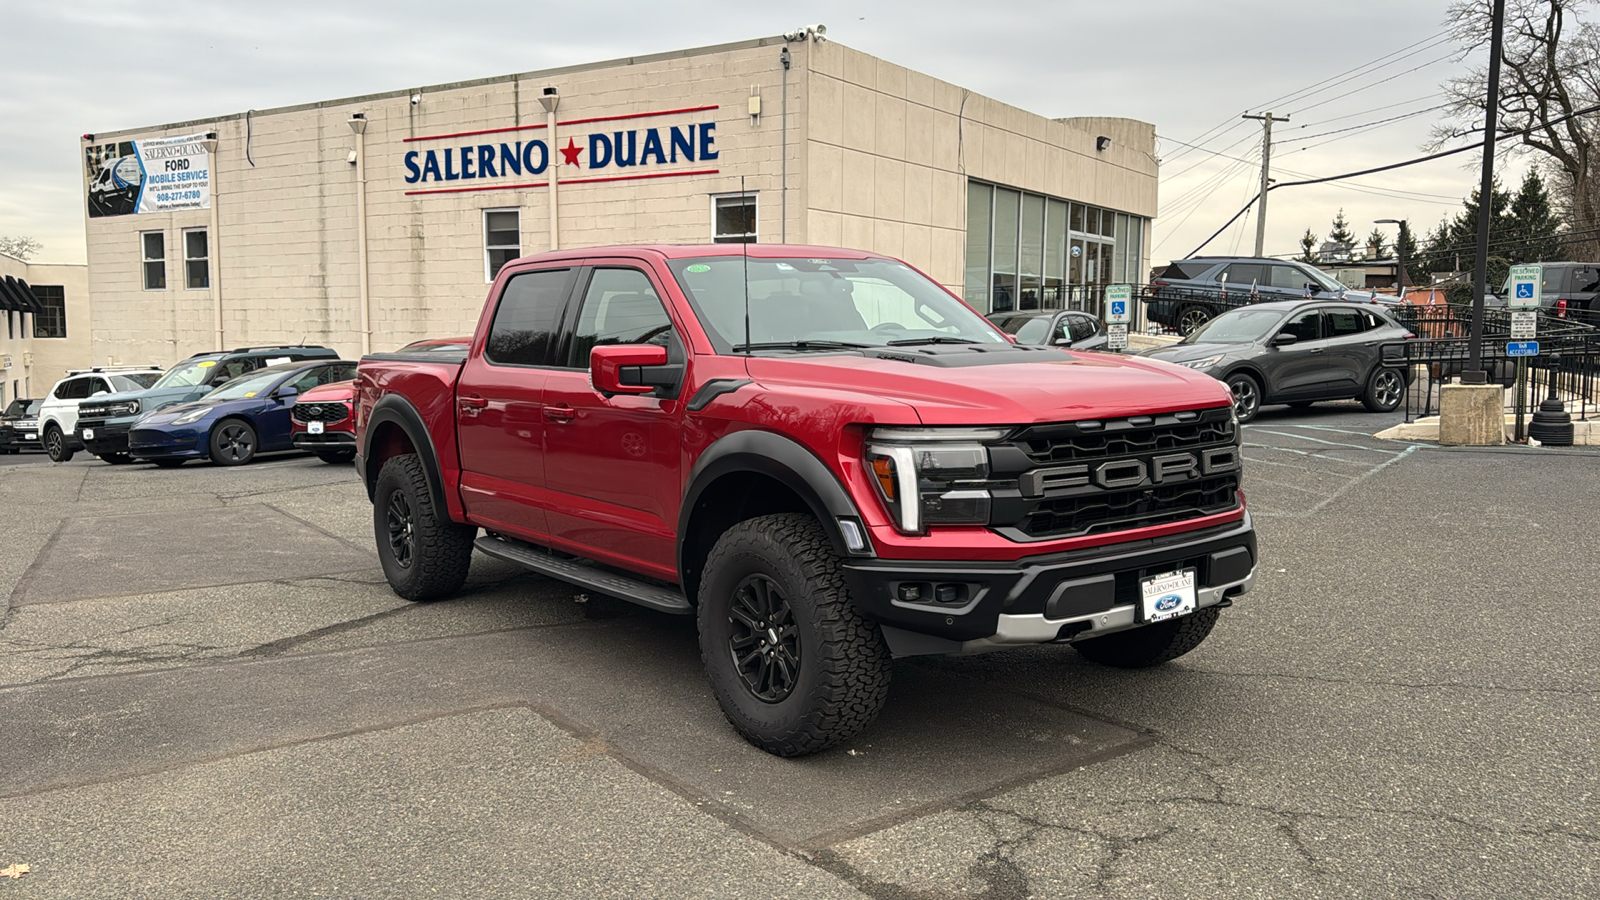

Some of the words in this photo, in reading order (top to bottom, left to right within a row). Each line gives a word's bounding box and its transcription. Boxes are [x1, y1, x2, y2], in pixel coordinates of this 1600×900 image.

[144, 147, 177, 159] SALERNO
[404, 139, 549, 184] SALERNO
[588, 122, 720, 169] DUANE
[165, 159, 190, 172] FORD
[149, 172, 176, 184] MOBILE
[177, 169, 208, 182] SERVICE
[156, 190, 201, 202] 908-277-6780
[1030, 445, 1239, 496] FORD
[1159, 597, 1177, 610] Ford
